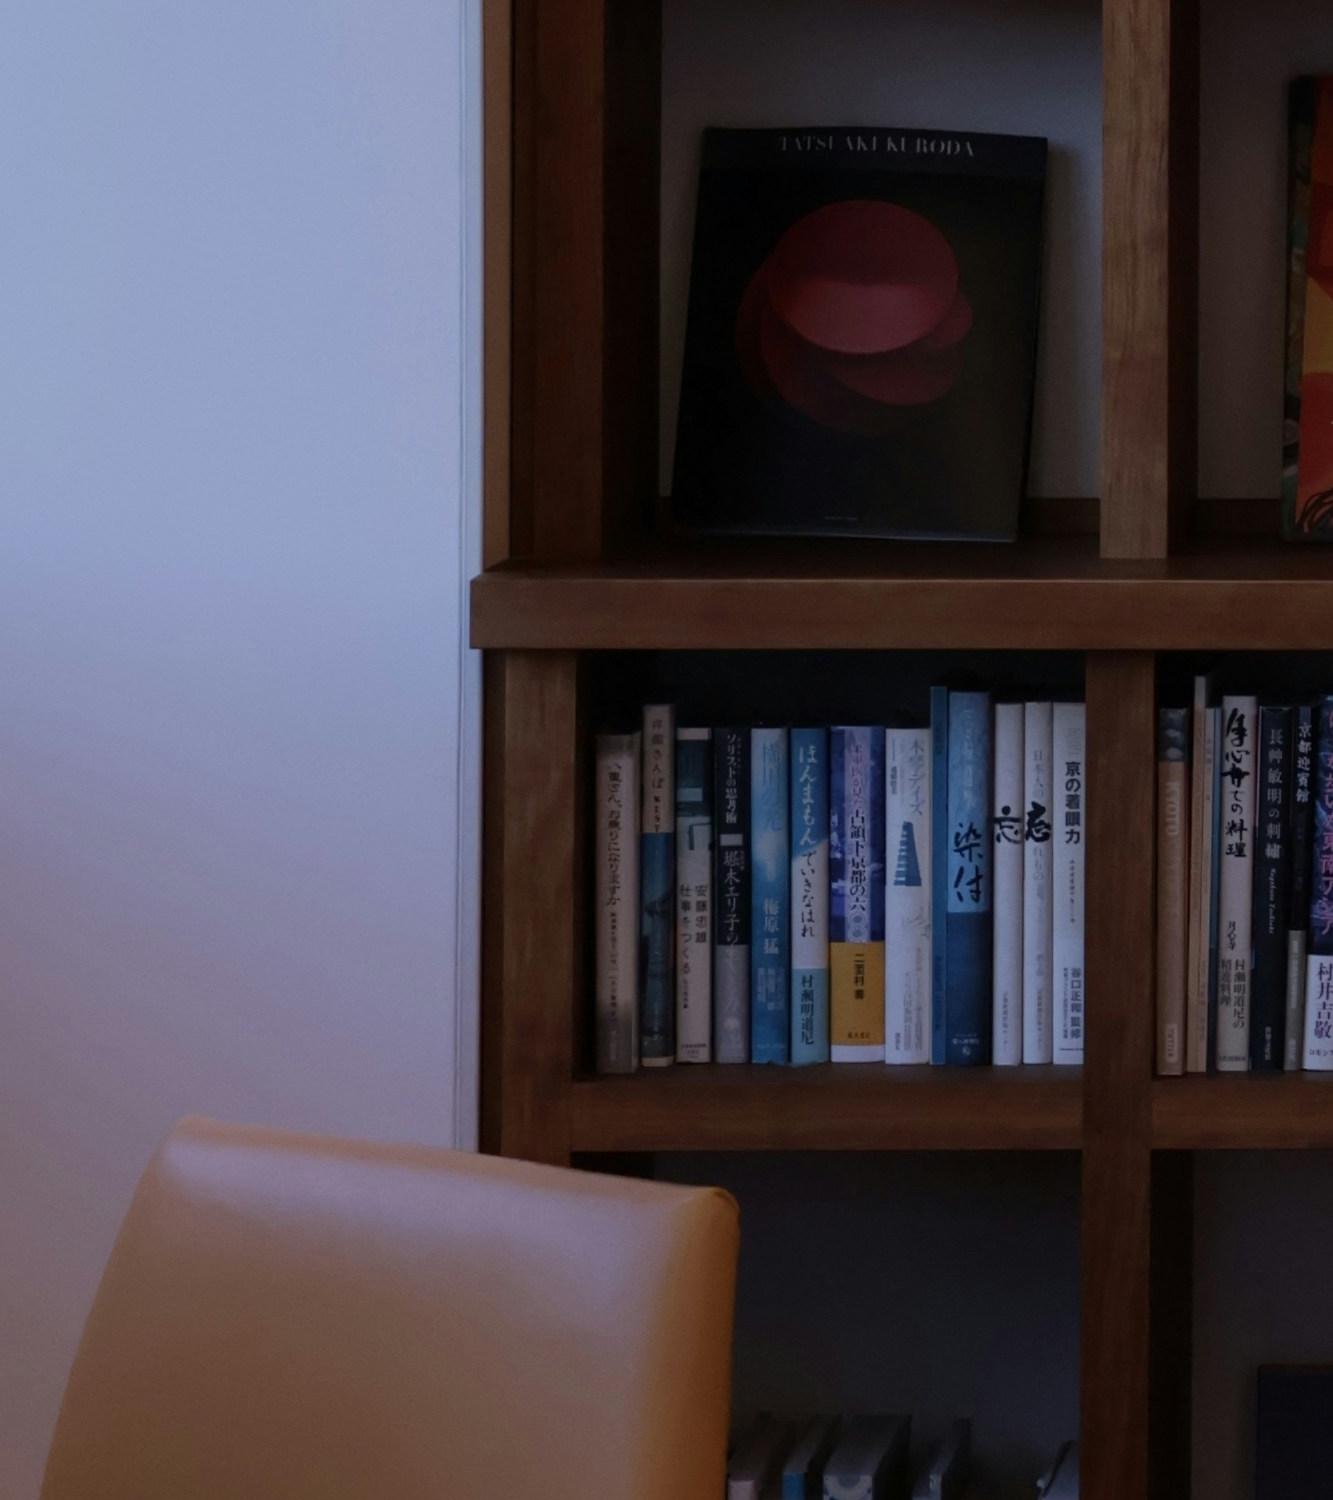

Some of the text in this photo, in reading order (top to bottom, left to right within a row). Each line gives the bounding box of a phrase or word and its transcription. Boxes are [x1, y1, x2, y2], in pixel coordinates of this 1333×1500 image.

[1296, 721, 1313, 804] 京都迎賓館
[1065, 761, 1081, 845] 京の着眼力
[952, 822, 984, 904] 染付
[695, 884, 708, 944] 安藤忠雄
[801, 974, 815, 1046] 村瀬明道尼
[1232, 958, 1246, 1030] 村瀬明道尼の
